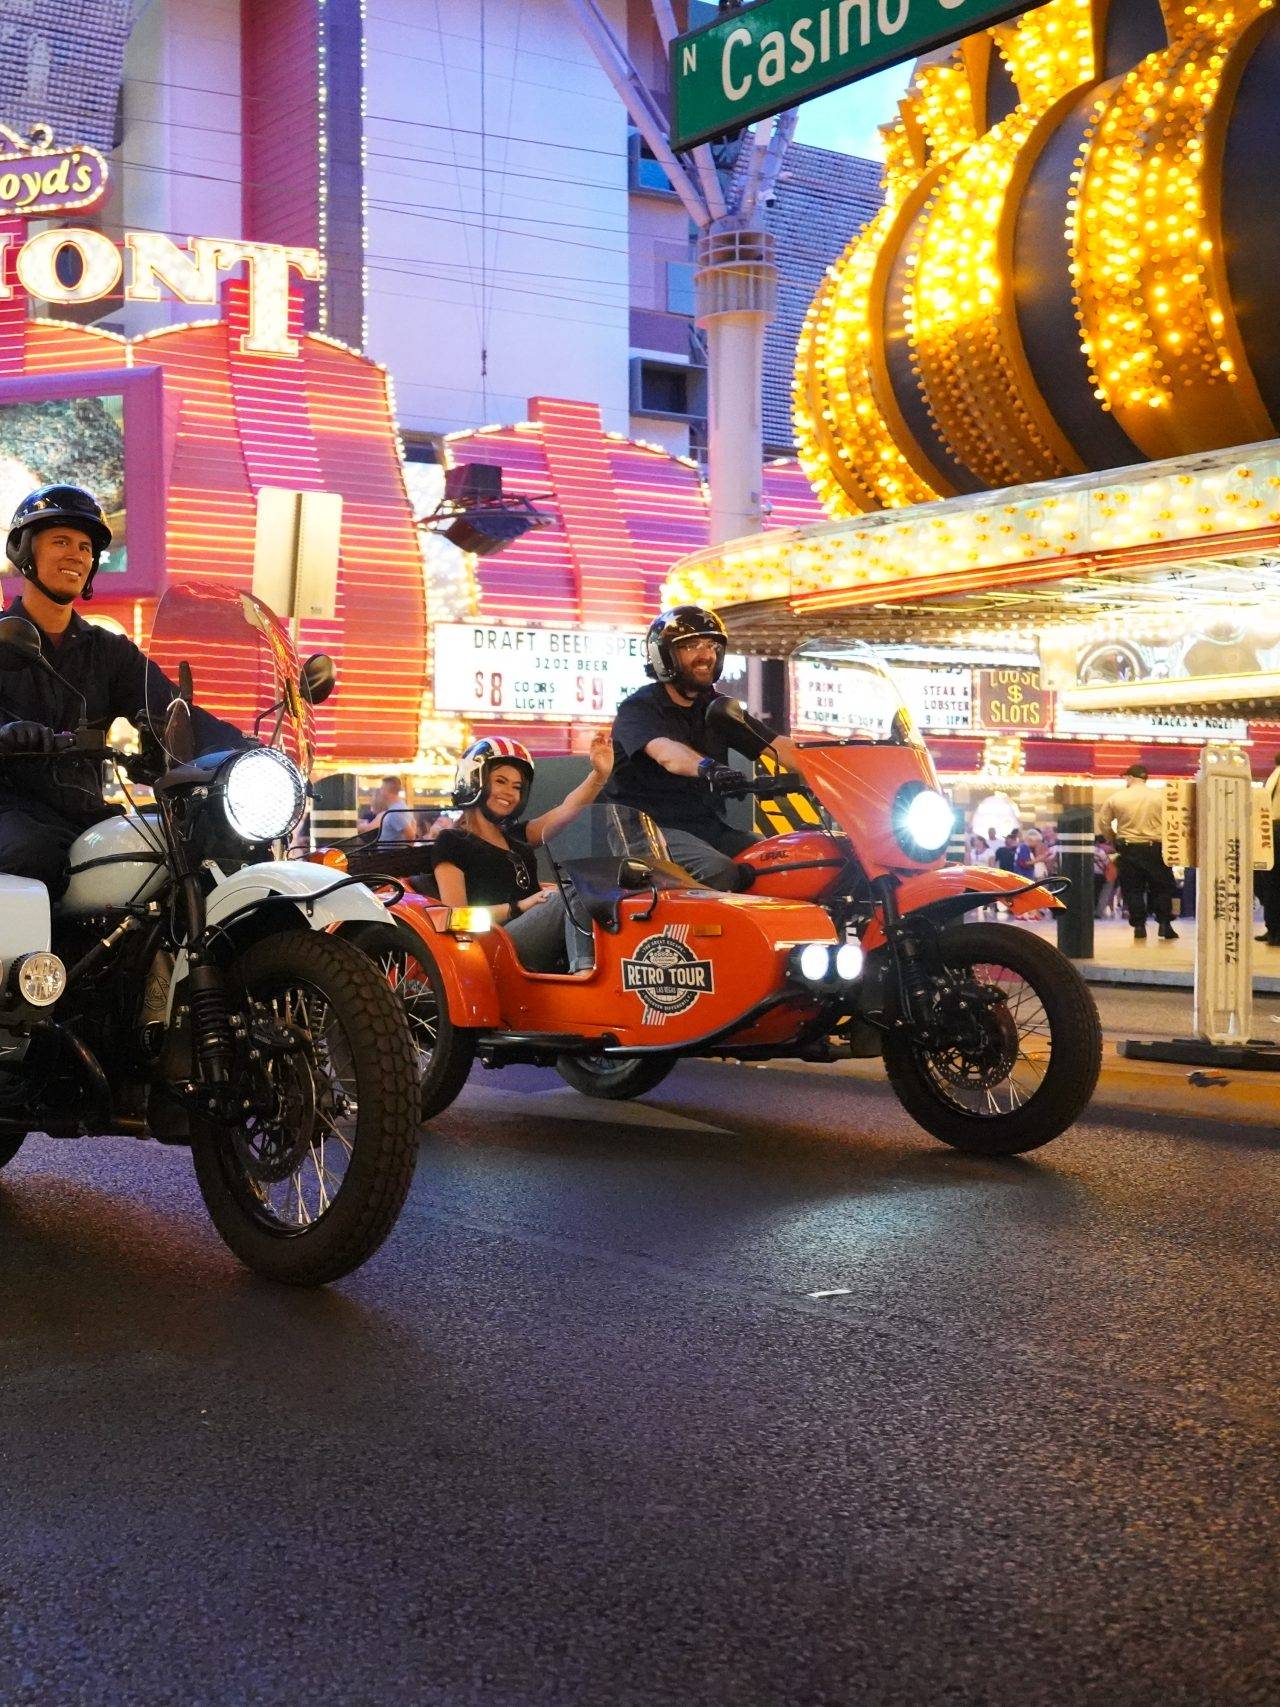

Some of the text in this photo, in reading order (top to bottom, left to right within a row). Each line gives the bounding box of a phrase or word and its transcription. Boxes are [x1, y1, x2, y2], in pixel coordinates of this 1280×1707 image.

[683, 0, 910, 101] N Casino
[474, 629, 536, 651] DRAFT
[549, 633, 593, 653] BEER
[577, 659, 608, 671] BEER
[514, 681, 556, 694] COORS
[809, 681, 842, 693] PRIME
[923, 685, 969, 696] STEAK &
[515, 698, 555, 710] LIGHT
[817, 696, 834, 707] RIB
[924, 700, 969, 711] LOBSTER
[990, 700, 1040, 725] SLOTS
[627, 964, 706, 987] RETRO TOUR
